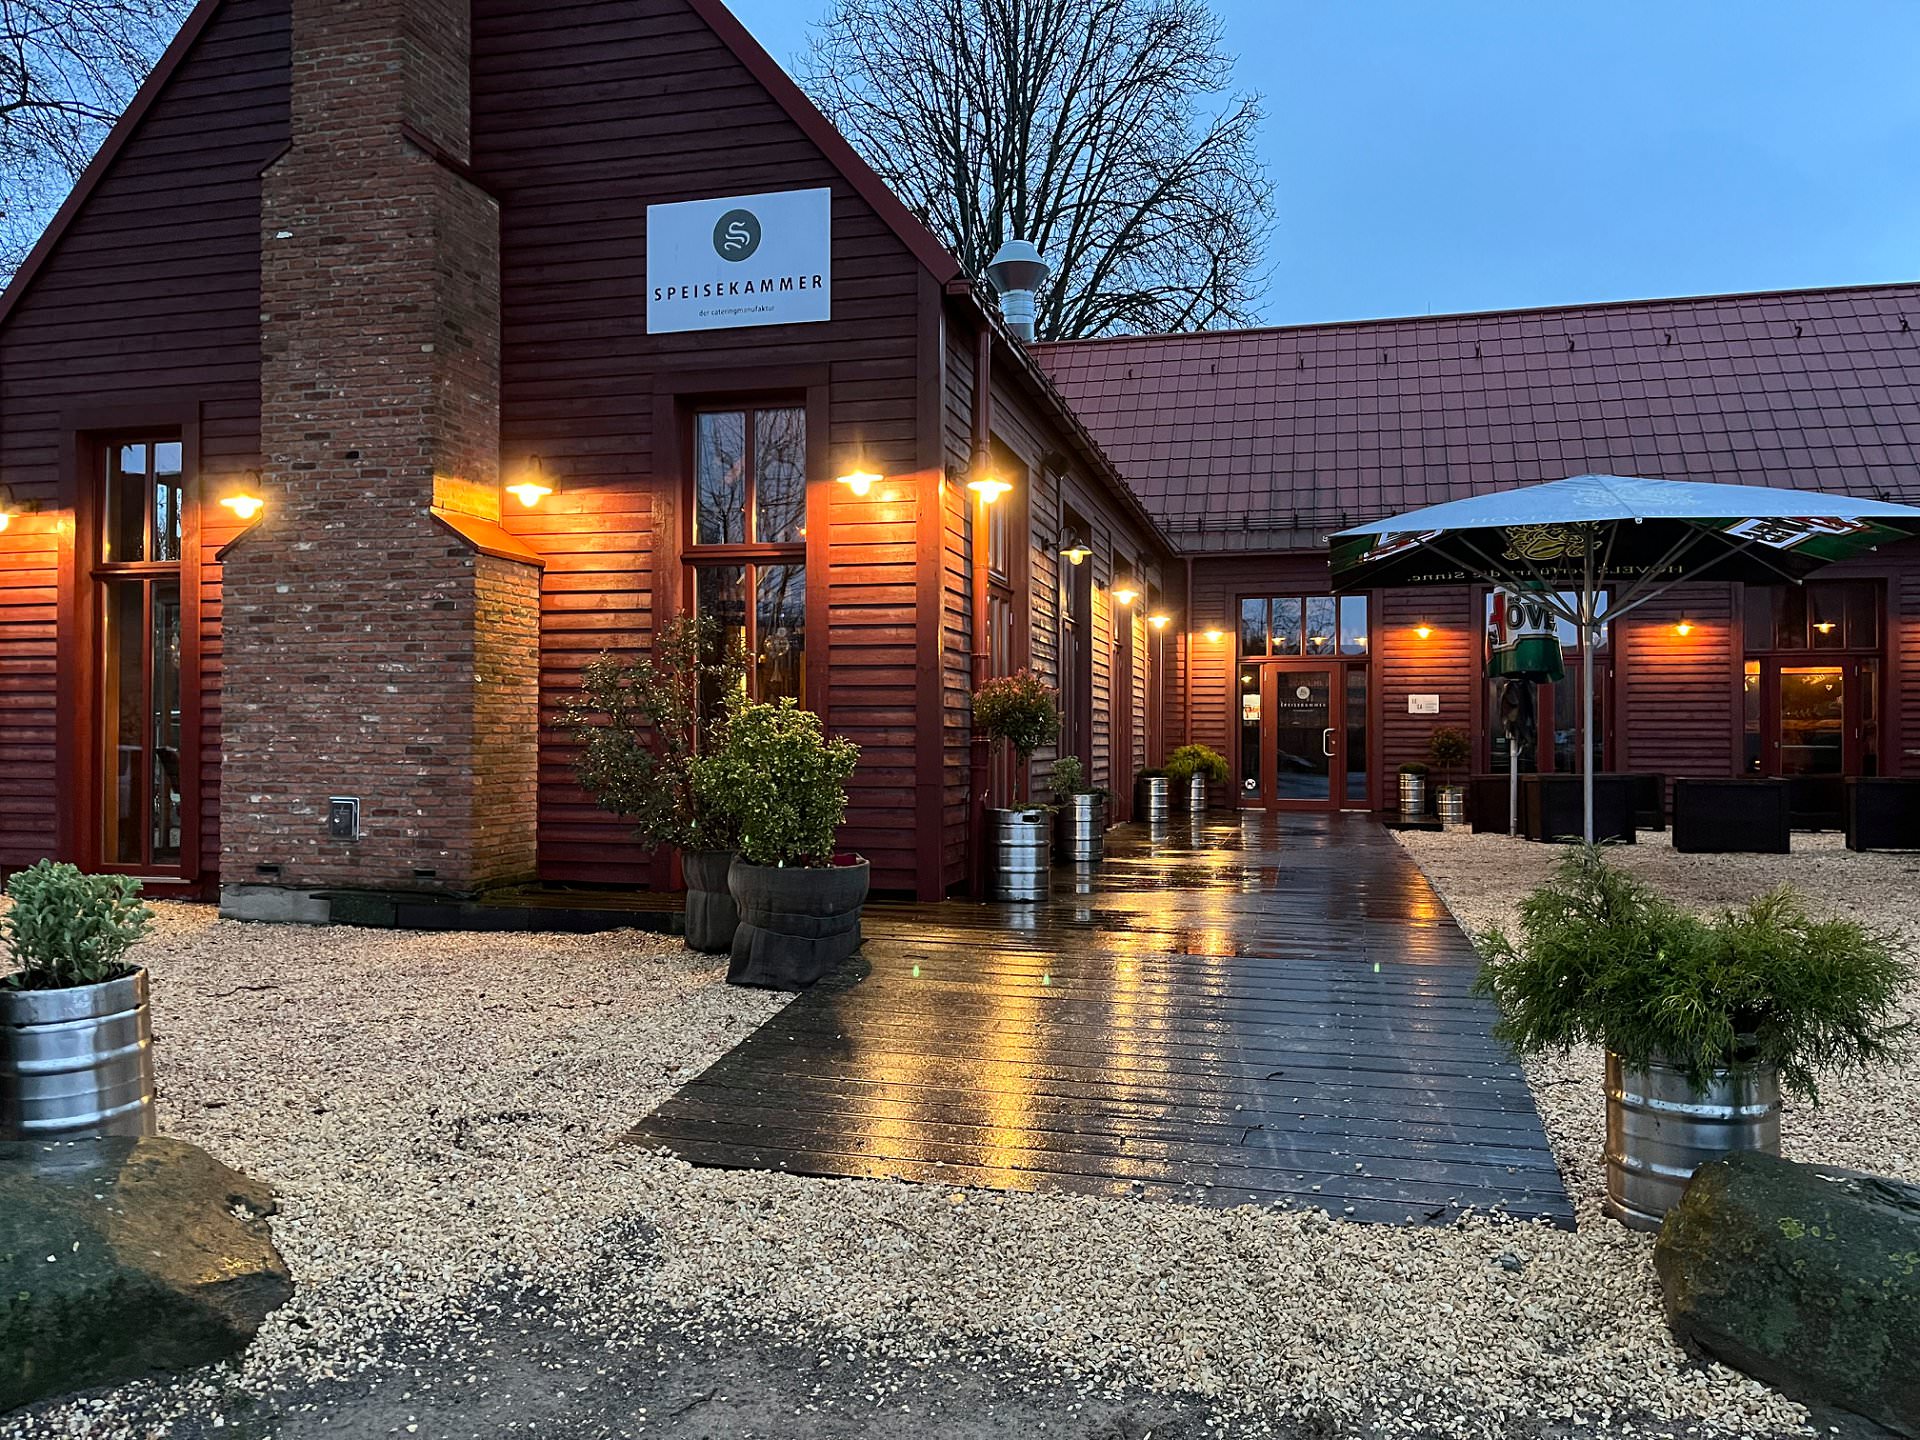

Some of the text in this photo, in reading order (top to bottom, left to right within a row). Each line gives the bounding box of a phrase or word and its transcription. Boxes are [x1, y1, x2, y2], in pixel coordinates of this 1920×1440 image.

[654, 274, 823, 302] SPEISEKAMMER
[698, 305, 775, 317] der cateringmanufaktur
